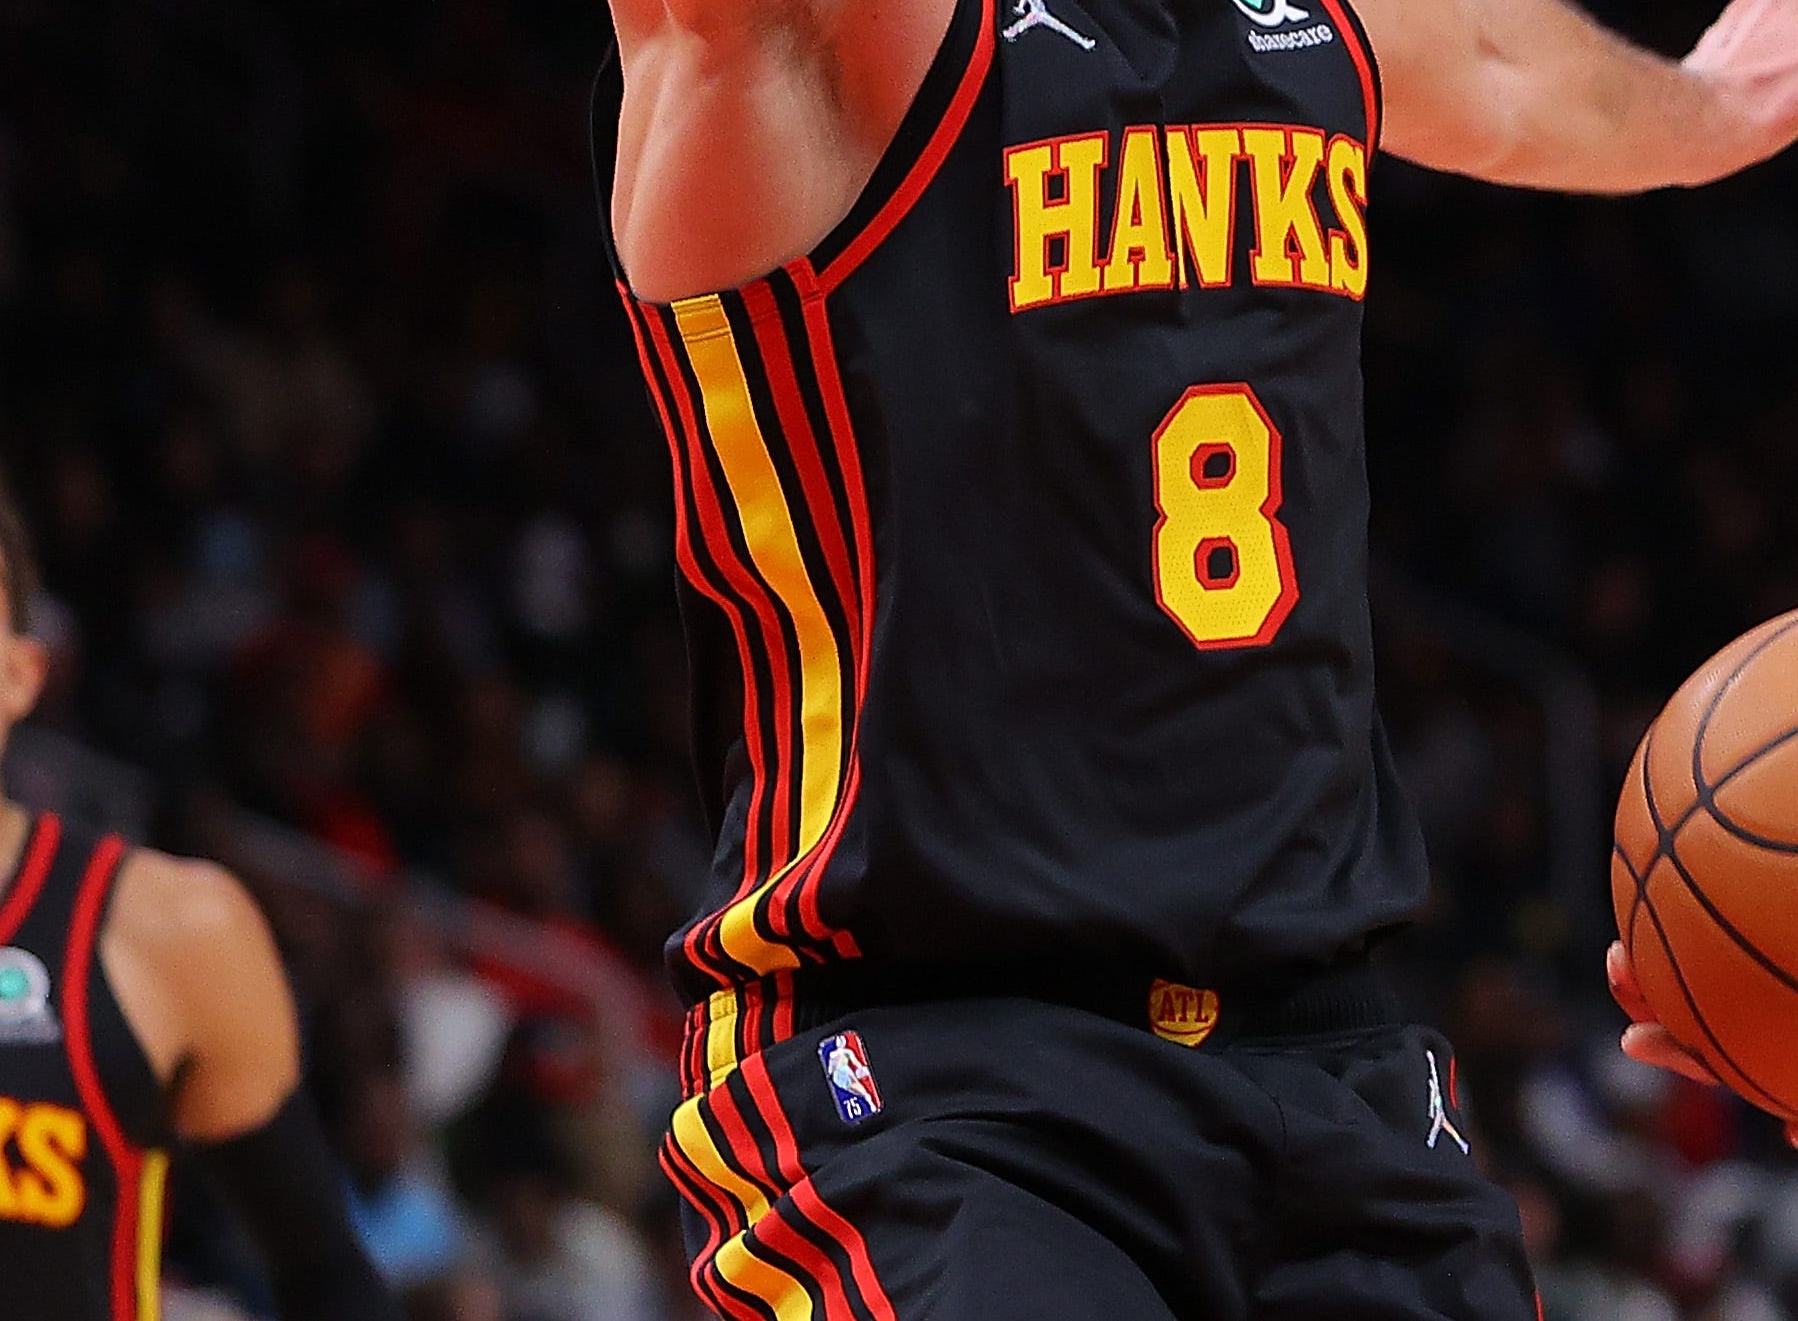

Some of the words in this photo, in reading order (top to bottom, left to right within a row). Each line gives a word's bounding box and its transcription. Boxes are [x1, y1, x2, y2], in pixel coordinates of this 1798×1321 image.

[1151, 381, 1299, 651] 8
[1157, 989, 1210, 1023] ATL
[843, 1096, 863, 1119] 75
